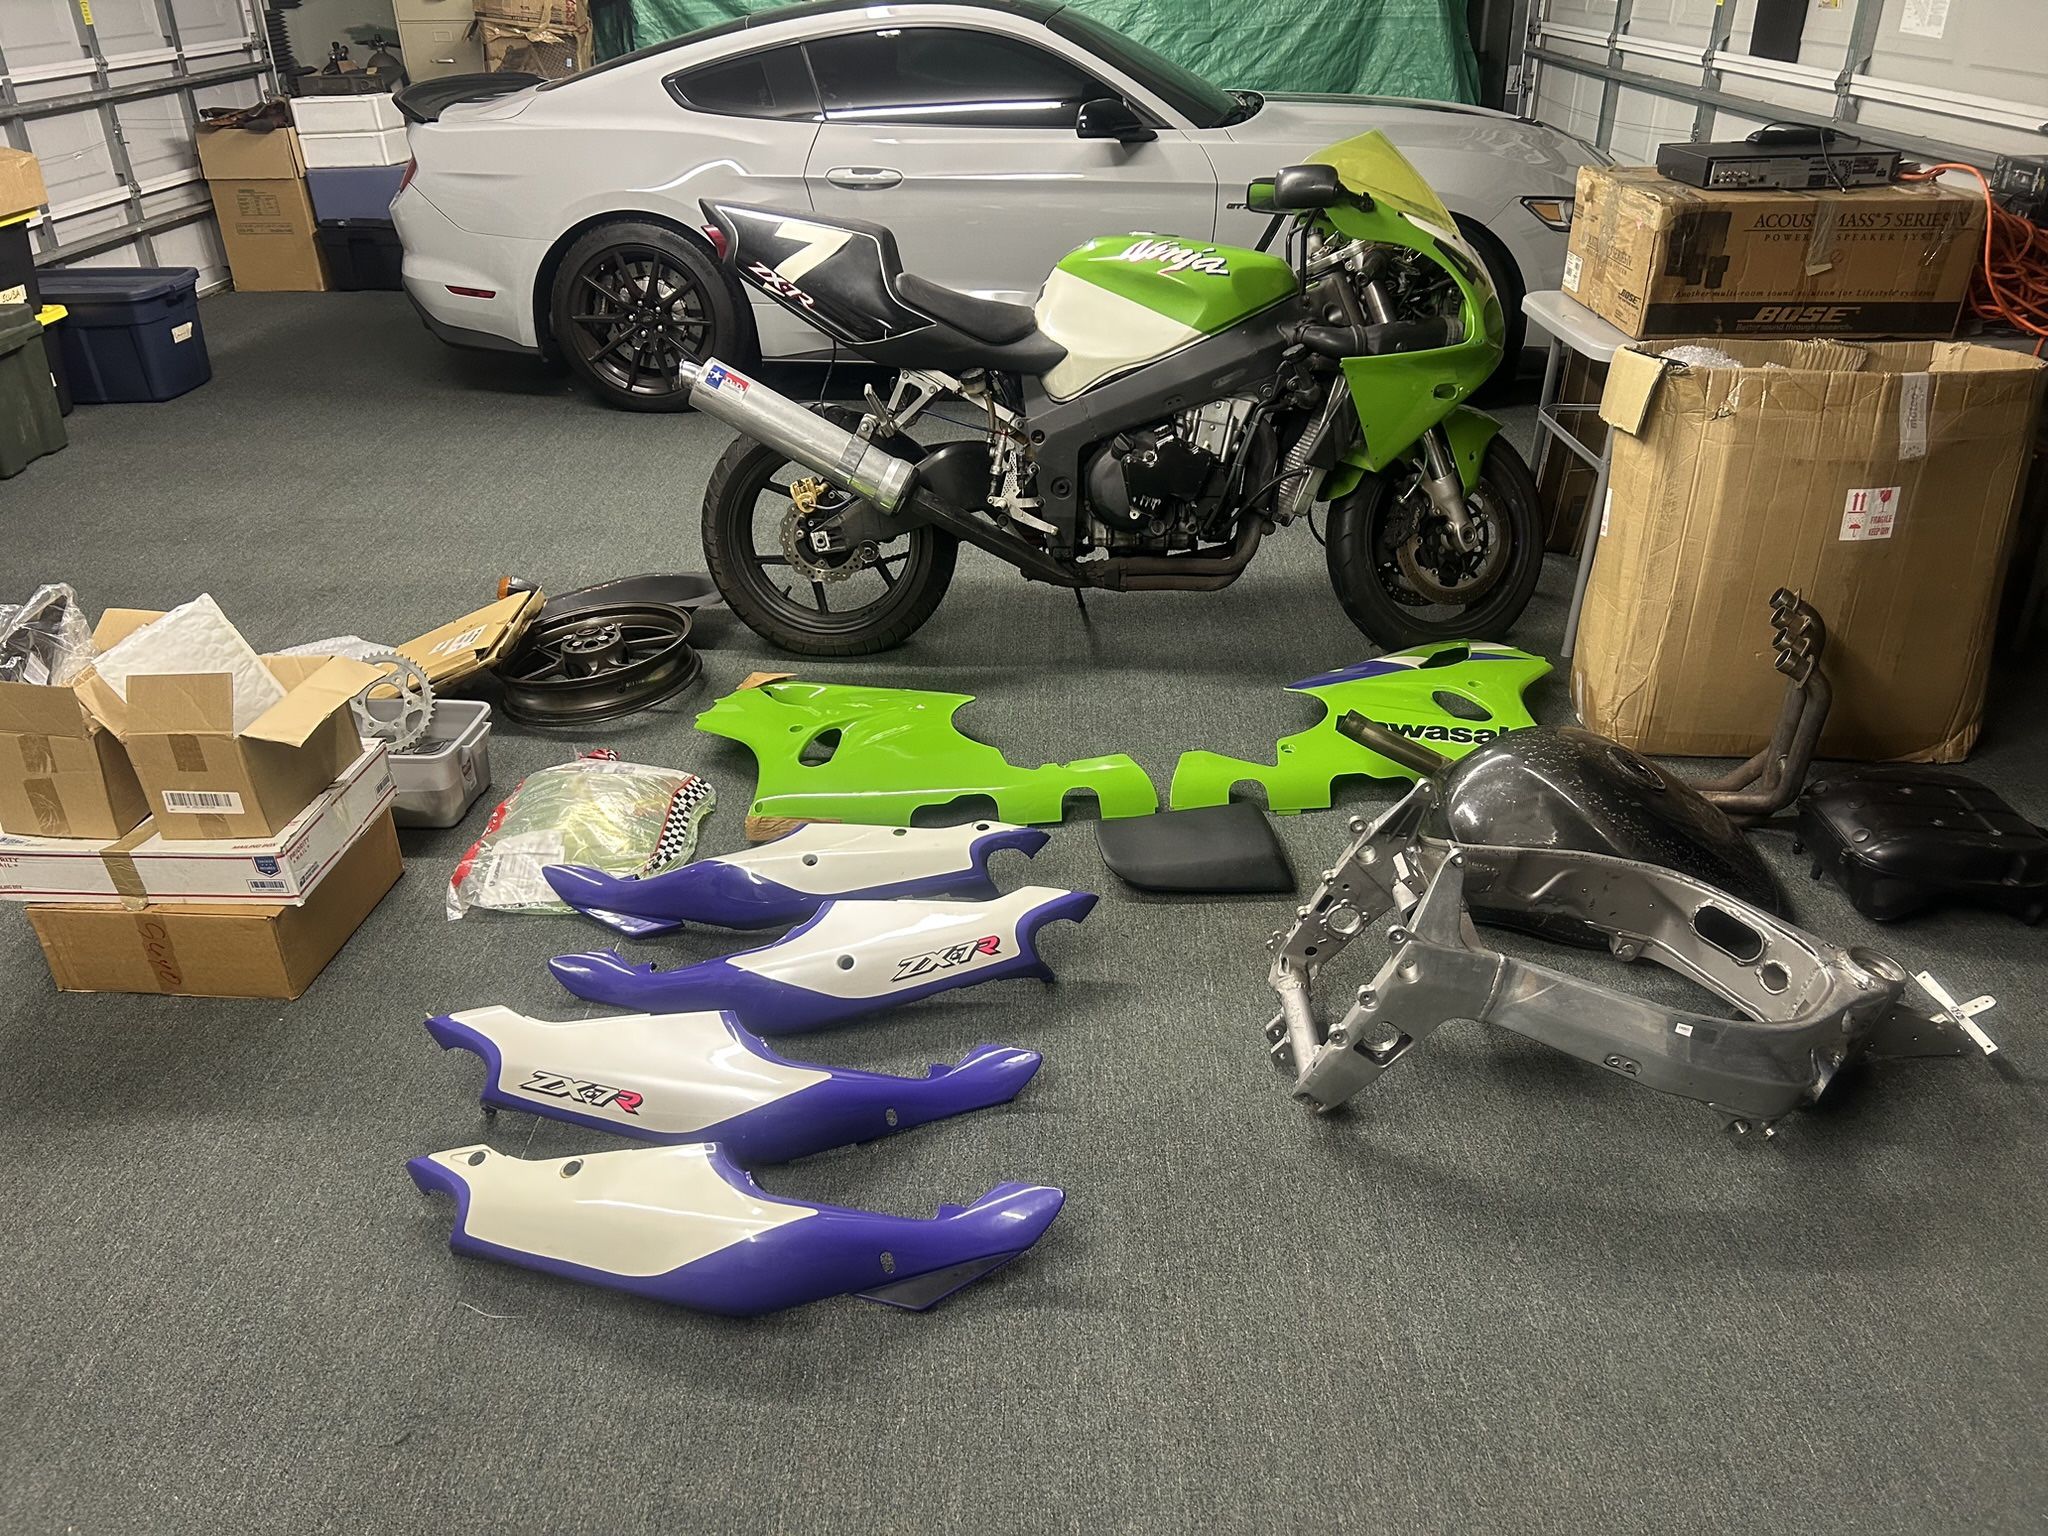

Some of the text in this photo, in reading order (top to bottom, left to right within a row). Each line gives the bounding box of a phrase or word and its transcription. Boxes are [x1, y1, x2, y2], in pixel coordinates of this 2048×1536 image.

[1880, 213, 1892, 227] 5
[1895, 213, 1949, 227] SERIES
[1836, 233, 1895, 241] SPEAKER
[763, 221, 853, 296] 7
[1119, 239, 1230, 276] Ninja
[1618, 288, 1641, 305] BOSE
[1737, 306, 1860, 323] BOSE
[1870, 514, 1893, 524] FRAGILE
[1868, 528, 1880, 536] KEEP
